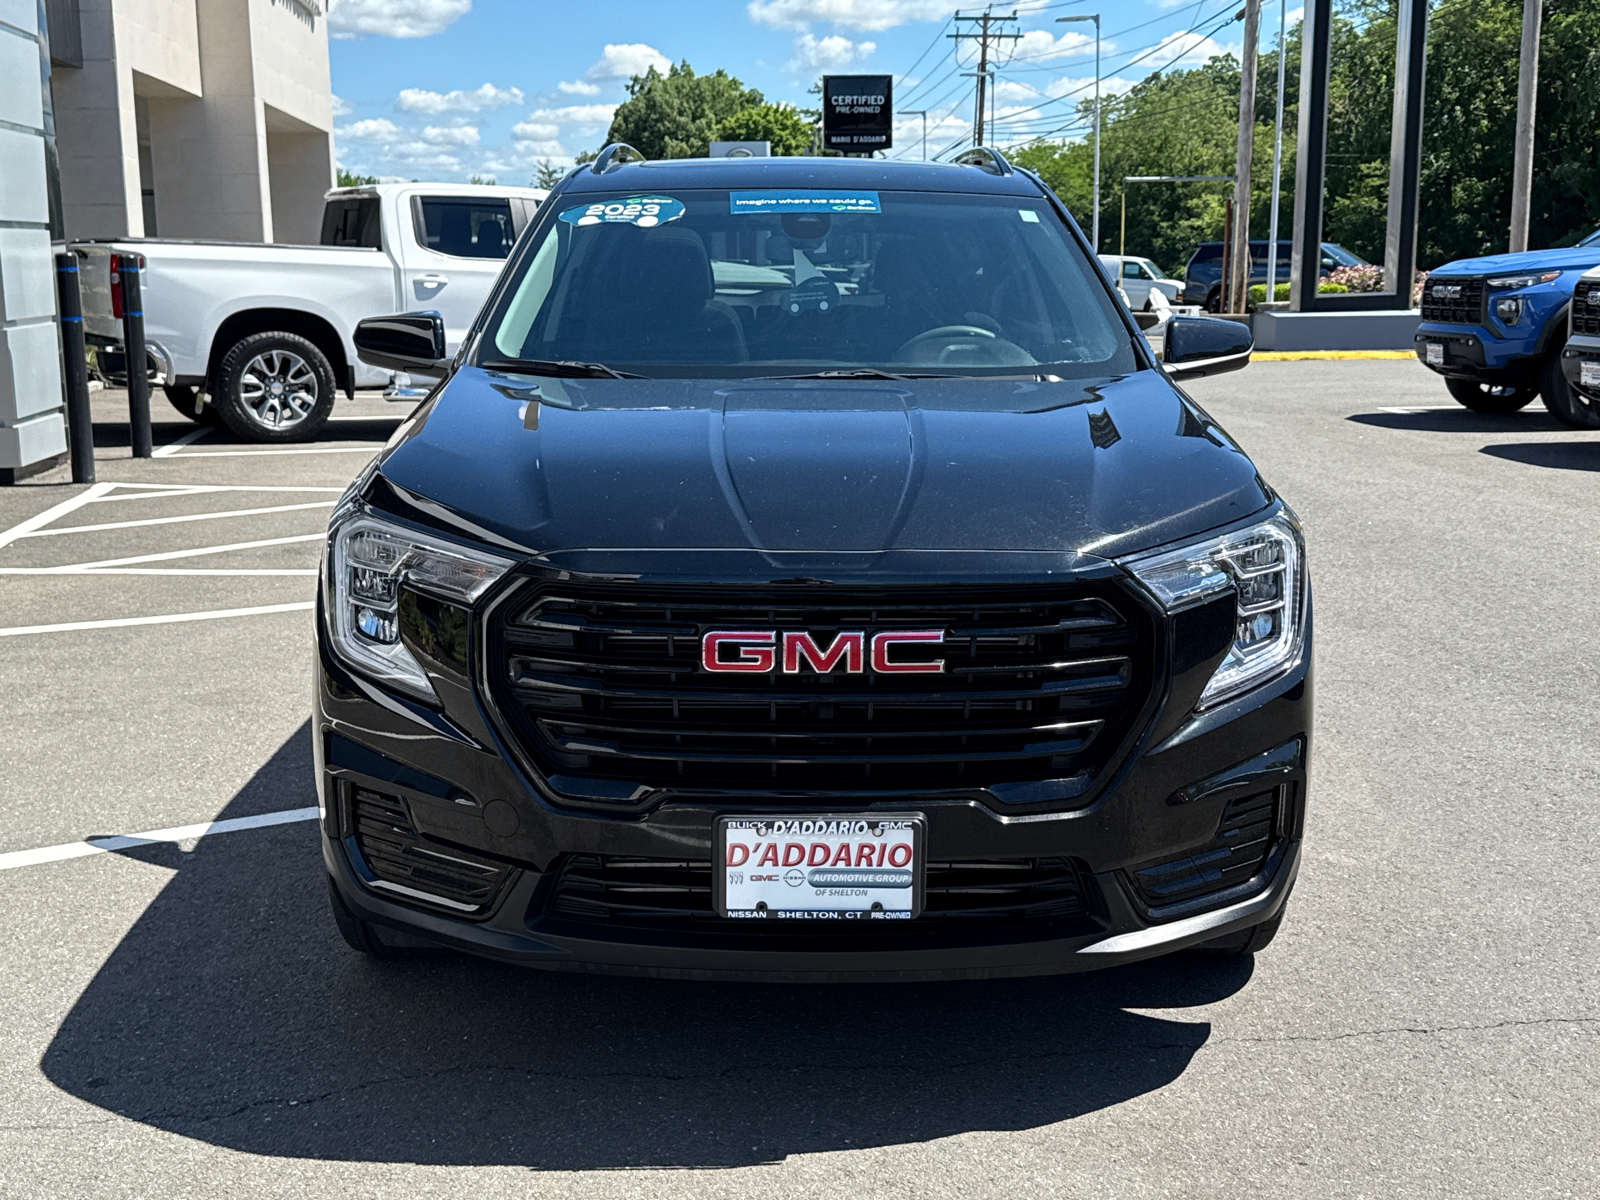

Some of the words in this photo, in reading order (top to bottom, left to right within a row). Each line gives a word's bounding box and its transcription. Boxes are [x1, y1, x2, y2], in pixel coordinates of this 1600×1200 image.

[831, 95, 885, 106] CERTIFIED
[835, 106, 881, 114] PRE-OWNED
[853, 135, 886, 143] D'ADDARIO
[585, 204, 661, 216] 2023
[702, 629, 946, 674] GMC
[727, 821, 767, 830] BUICK
[772, 820, 869, 836] D'ADDARIO
[877, 821, 913, 831] GMC
[726, 842, 913, 868] D'ADDARIO
[750, 874, 780, 882] GMC
[813, 873, 874, 883] AUTOMOTIVE
[875, 873, 909, 884] GROUP
[815, 889, 827, 897] OF
[828, 888, 868, 897] SHELTON
[727, 910, 767, 919] NISSAN
[777, 910, 842, 920] SHELTON,
[845, 910, 863, 919] CT
[871, 911, 911, 919] PRE-OWNED
